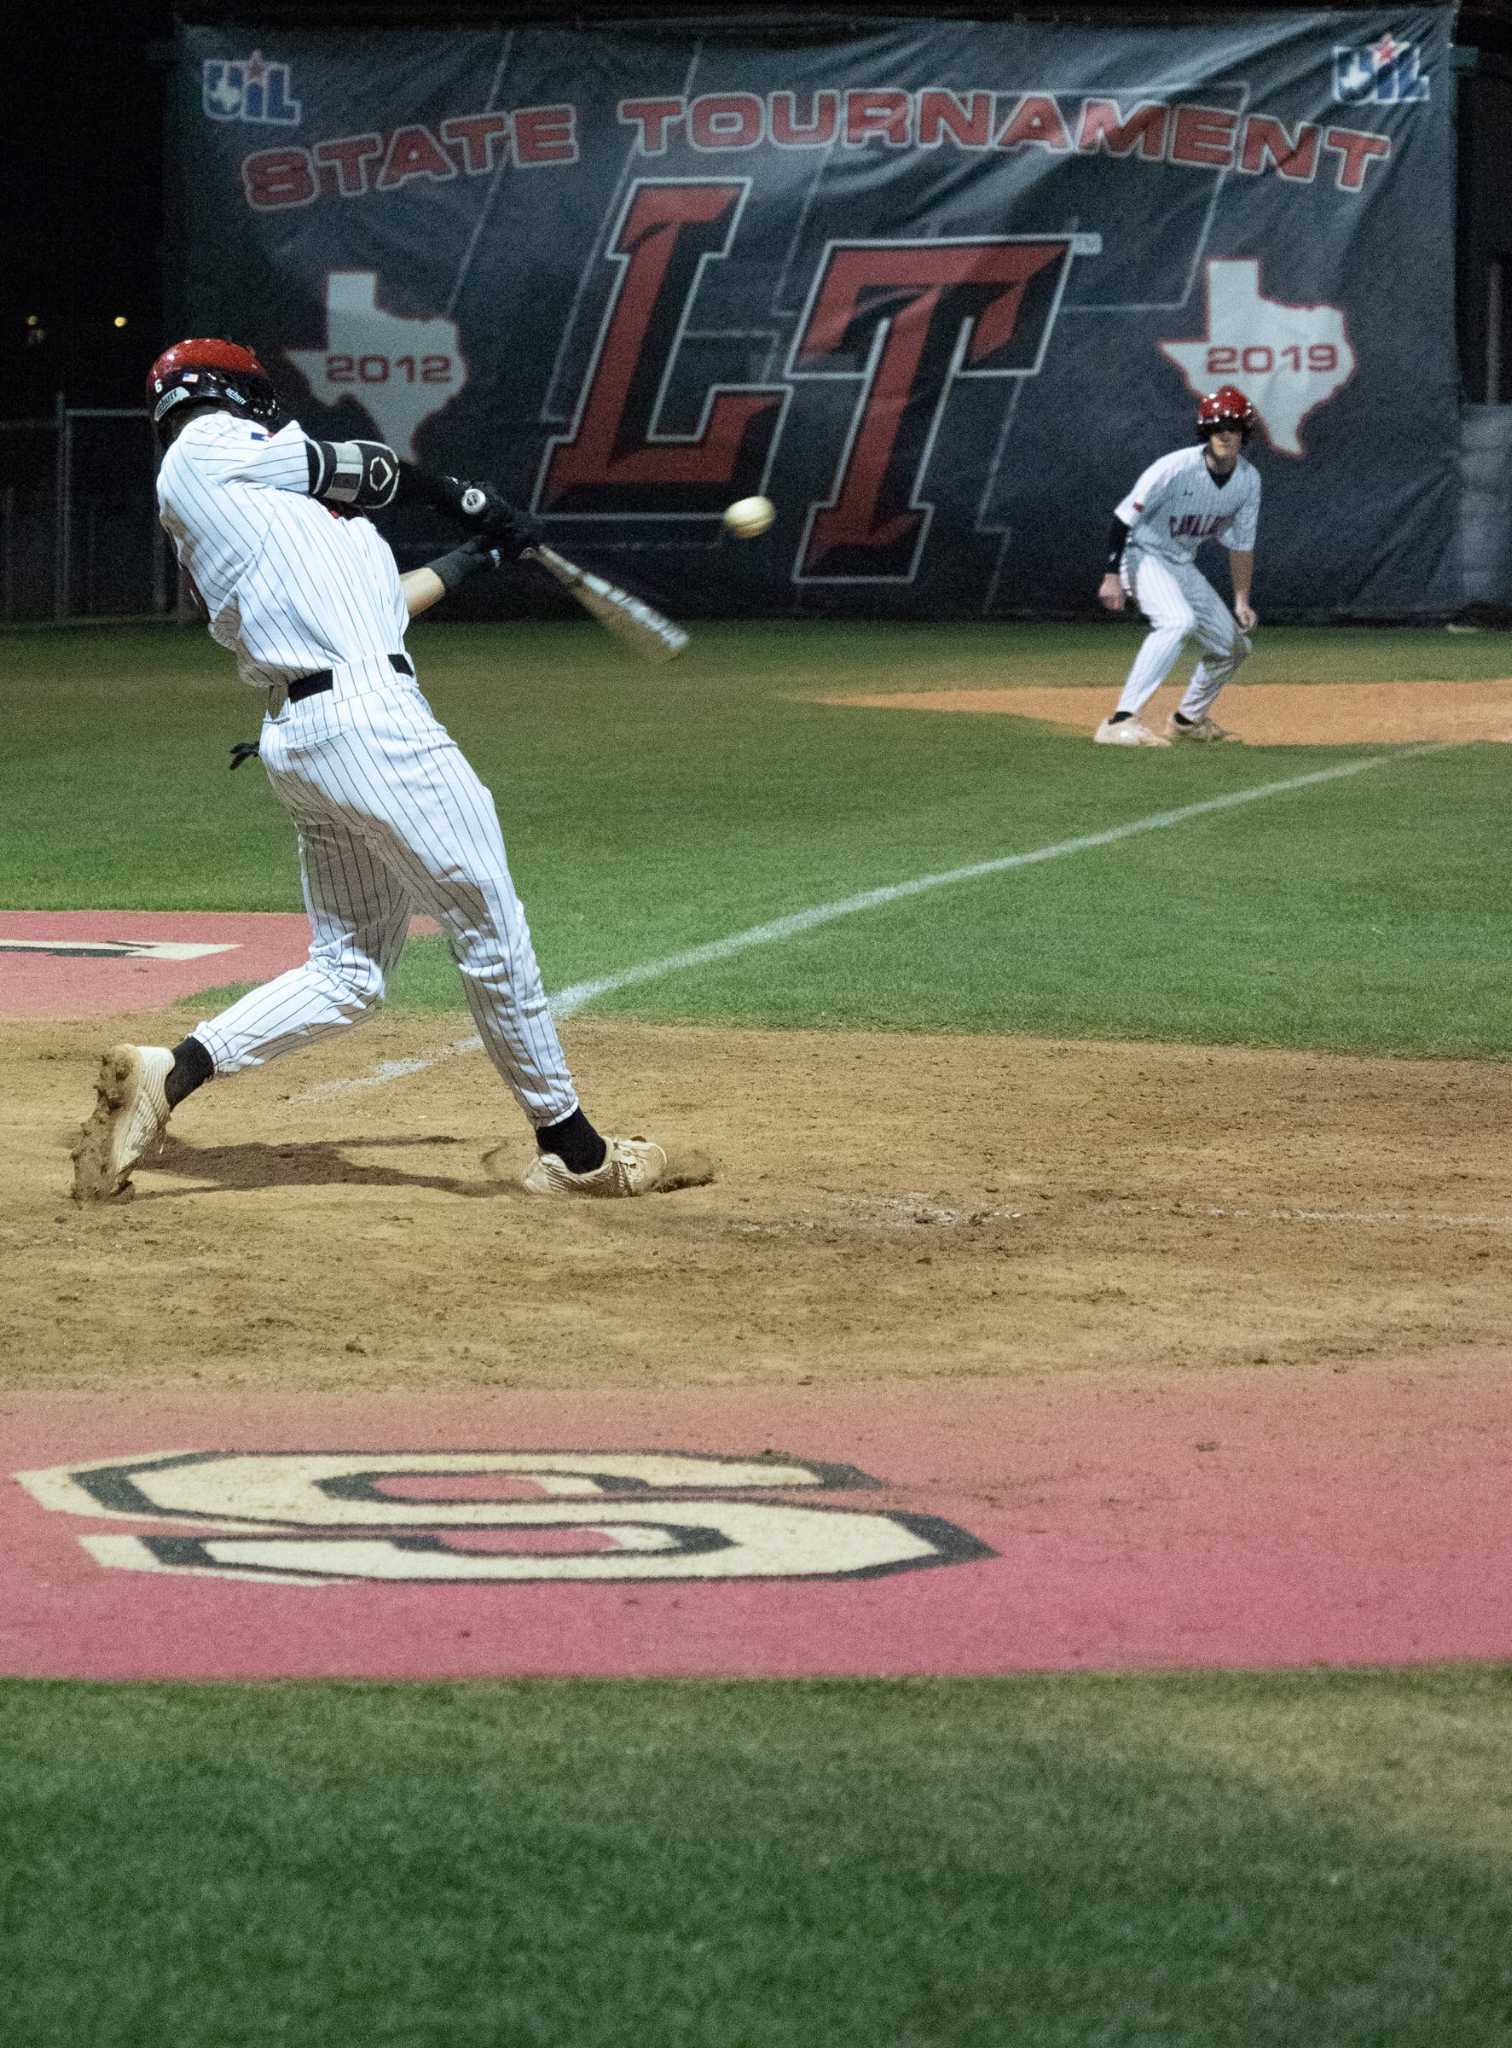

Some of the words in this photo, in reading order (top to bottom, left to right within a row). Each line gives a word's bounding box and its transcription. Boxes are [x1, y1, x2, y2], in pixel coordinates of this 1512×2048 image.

[241, 103, 581, 212] STATE
[617, 85, 1392, 193] TOURNAMENT
[326, 355, 452, 383] 2012
[1206, 345, 1338, 374] 2019
